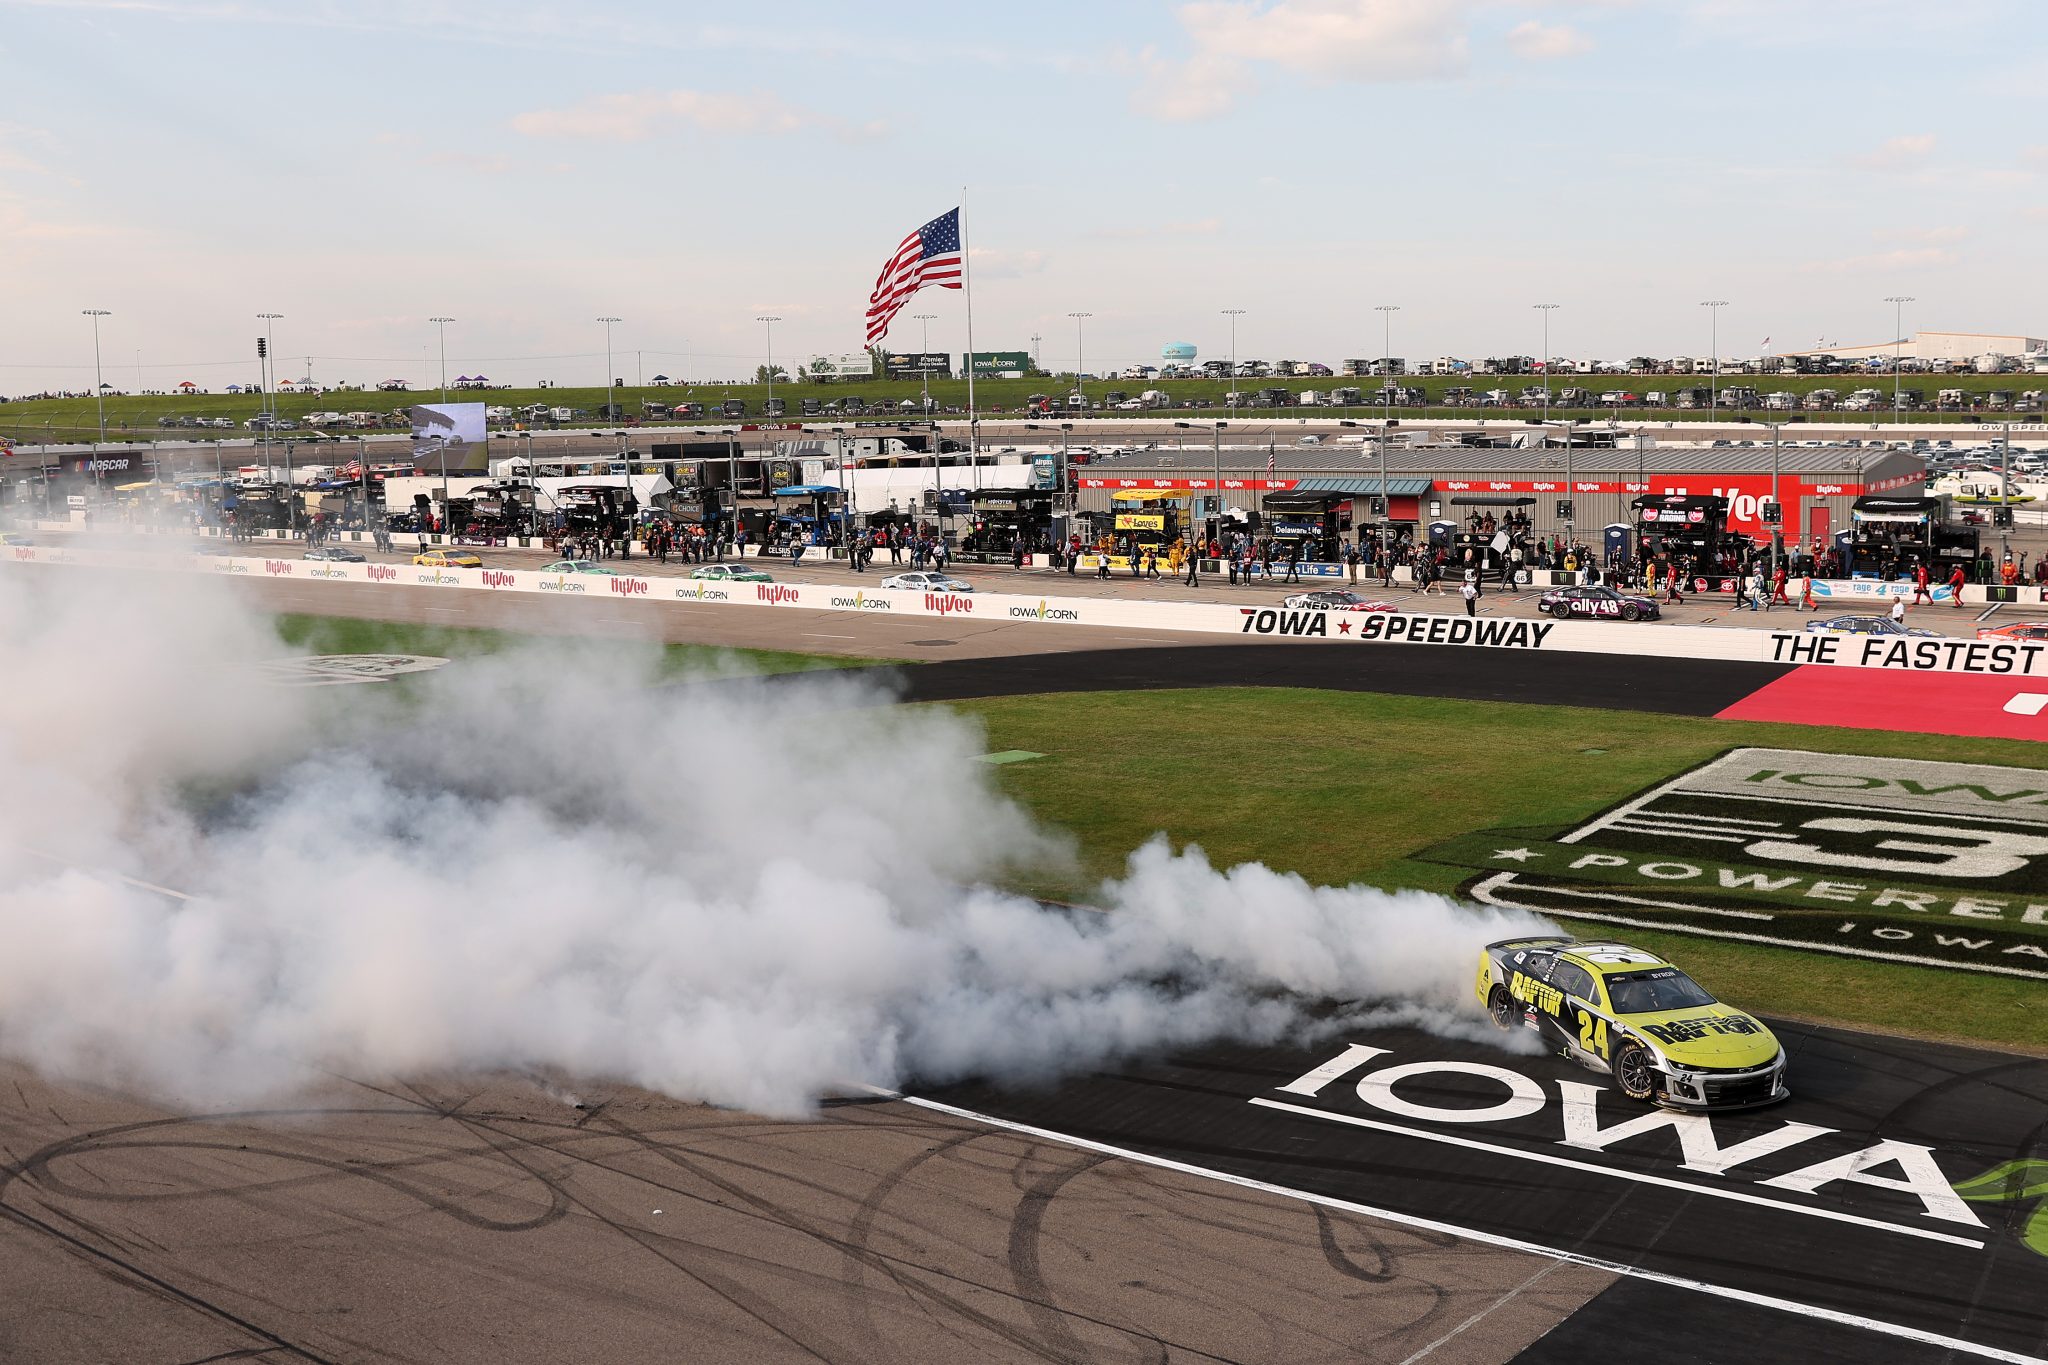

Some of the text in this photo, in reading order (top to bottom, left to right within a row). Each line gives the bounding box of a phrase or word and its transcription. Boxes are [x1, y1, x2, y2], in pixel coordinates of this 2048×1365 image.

[88, 459, 129, 471] NASCAR
[1448, 482, 1469, 490] HyVee
[1490, 482, 1512, 490] HyVee
[1533, 482, 1555, 490] HyVee
[1577, 483, 1600, 491] HyVee
[1816, 485, 1842, 495] HyVee
[678, 504, 699, 512] CHOICE
[1133, 518, 1158, 528] Love's
[1659, 514, 1686, 522] RACING
[265, 560, 292, 576] HyVee
[310, 569, 348, 578] IOWA CORN
[368, 565, 397, 582] HyVee
[1302, 565, 1319, 574] Life
[418, 574, 460, 584] IOWA CORN
[482, 571, 514, 588] HyVee
[539, 582, 585, 592] IOWA CORN
[611, 577, 648, 596] HyVee
[1853, 584, 1910, 596] rage 4 rage
[675, 589, 728, 600] IOWA CORN
[757, 584, 799, 605] HyVee
[831, 597, 890, 609] IOWA CORN
[925, 593, 973, 616] HyVee
[1571, 598, 1619, 615] ally 48
[1010, 607, 1078, 620] IOWA CORN
[1240, 608, 1555, 648] IOWA SPEEDWAY
[1770, 634, 2044, 674] THE FASTEST
[1745, 769, 2048, 802] IOW
[1651, 971, 1676, 979] BYRON
[1510, 970, 1564, 1018] RAPTOR
[1578, 1009, 1609, 1061] 24
[1640, 1015, 1764, 1045] RAPTOR
[1680, 1073, 1693, 1083] 24
[1273, 1043, 1990, 1229] IOWA
